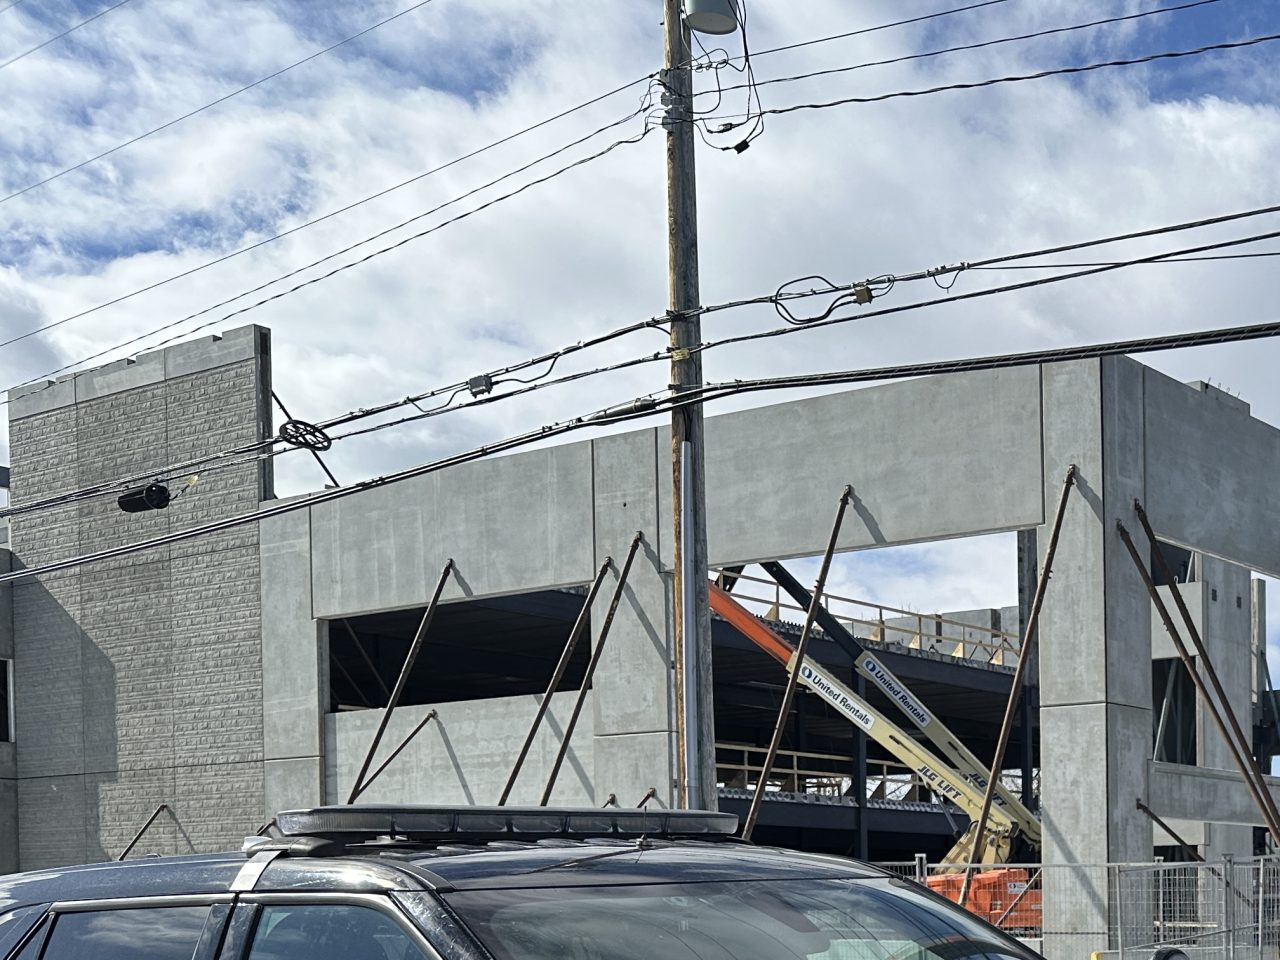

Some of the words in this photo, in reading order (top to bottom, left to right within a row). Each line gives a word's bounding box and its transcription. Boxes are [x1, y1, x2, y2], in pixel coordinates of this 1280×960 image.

[812, 675, 841, 701] United
[839, 696, 872, 725] Rentals
[875, 670, 902, 697] United
[898, 694, 927, 724] Rentals
[917, 765, 939, 781] JLG
[937, 779, 962, 800] LIFT
[969, 773, 988, 788] JLG
